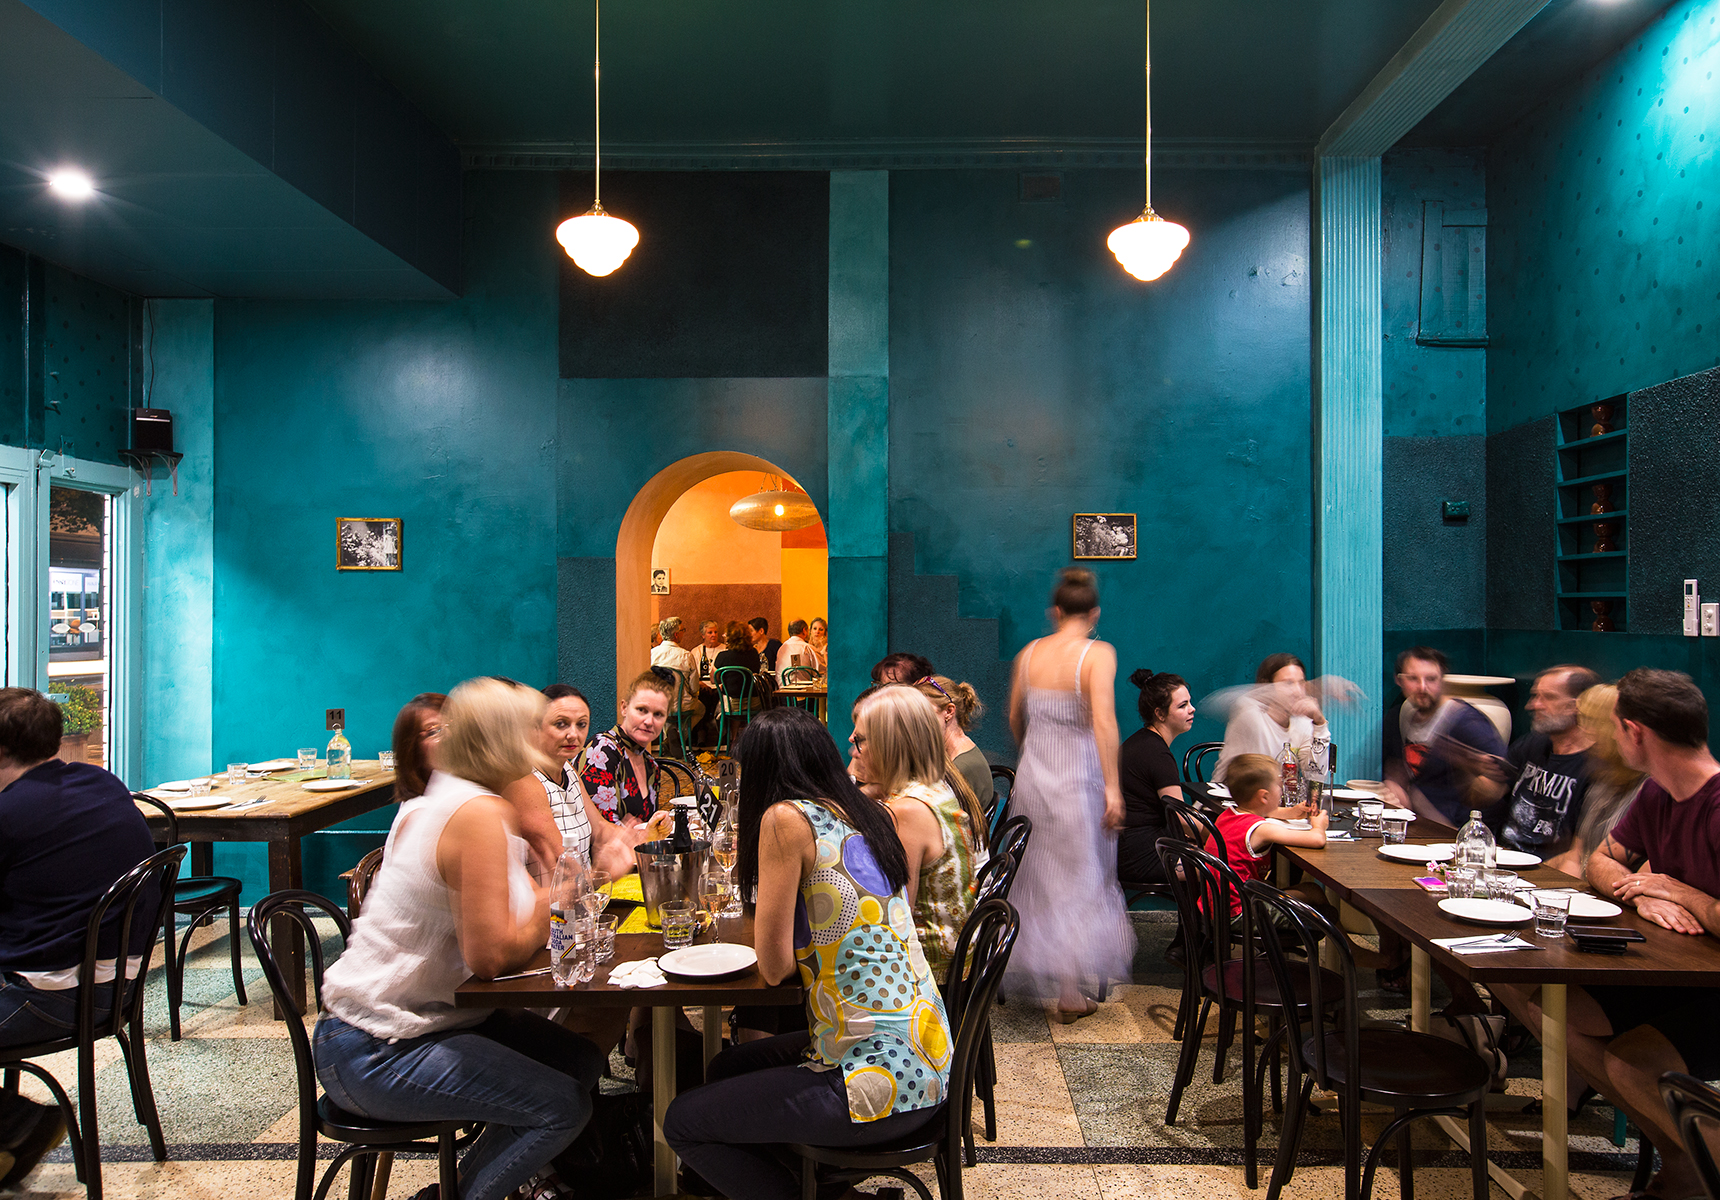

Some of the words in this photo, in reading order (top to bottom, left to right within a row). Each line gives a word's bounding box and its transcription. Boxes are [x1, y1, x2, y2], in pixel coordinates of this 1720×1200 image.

[330, 710, 341, 720] 11
[721, 762, 734, 776] 20
[700, 793, 718, 823] 21
